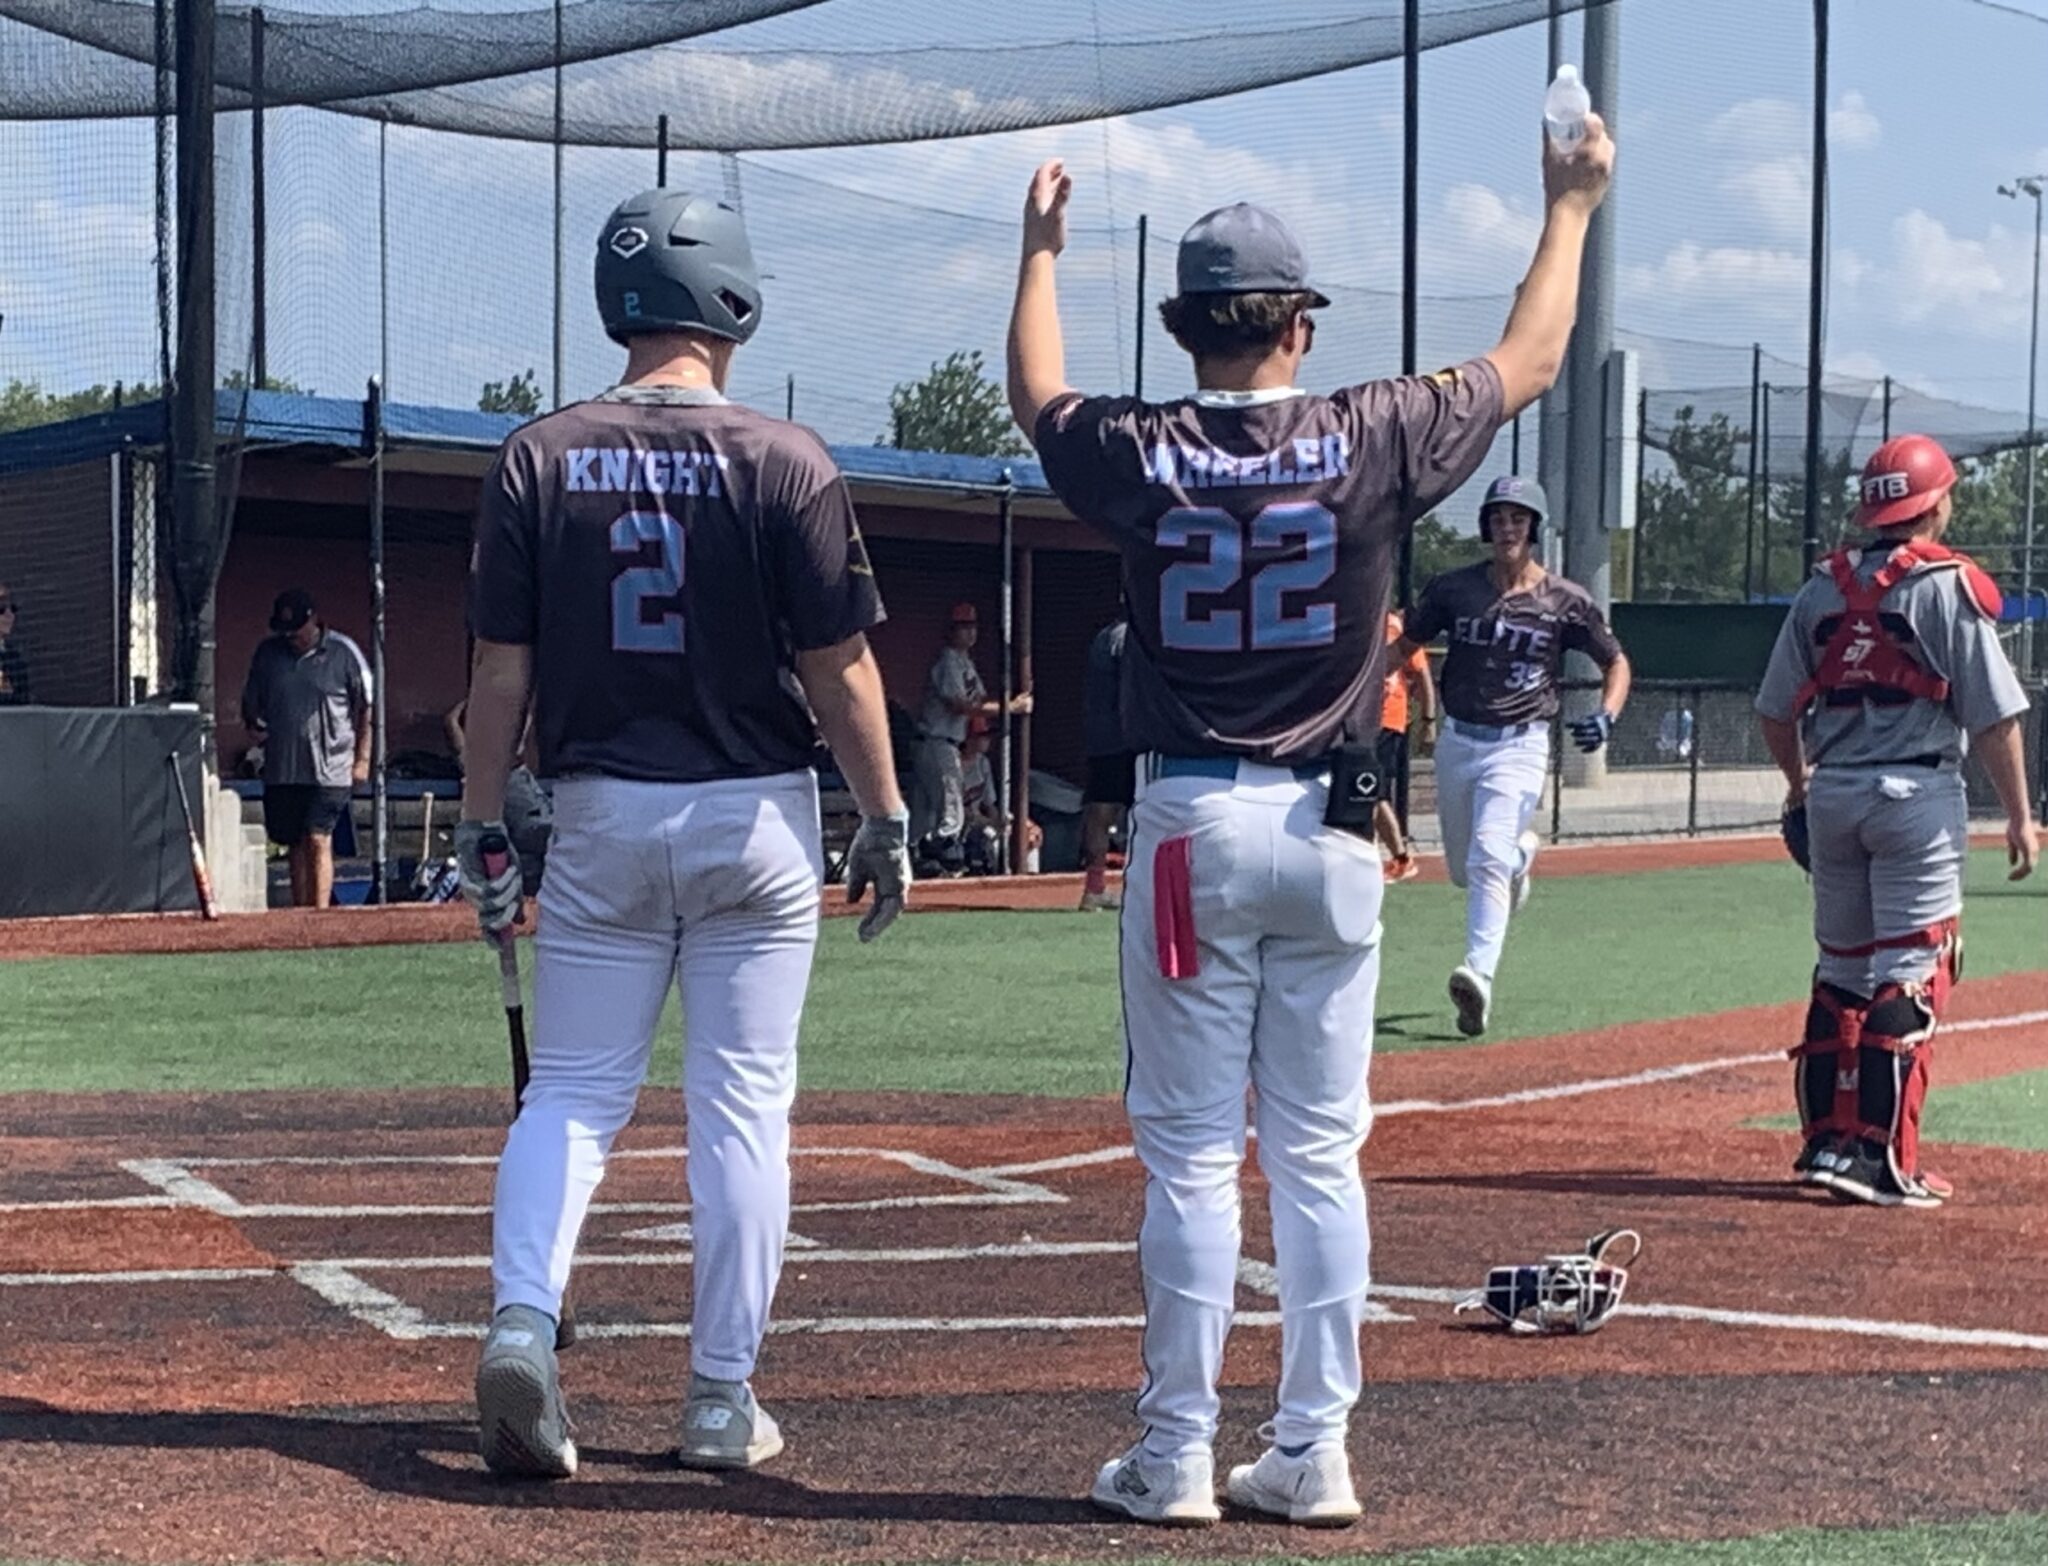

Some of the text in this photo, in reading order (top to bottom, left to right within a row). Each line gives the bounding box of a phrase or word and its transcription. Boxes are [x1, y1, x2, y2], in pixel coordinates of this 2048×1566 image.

[624, 291, 641, 320] 2
[566, 447, 729, 498] KNIGHT
[1863, 472, 1909, 504] FTB
[610, 510, 685, 653] 2
[1155, 501, 1338, 652] 22
[1454, 616, 1553, 656] ELITE
